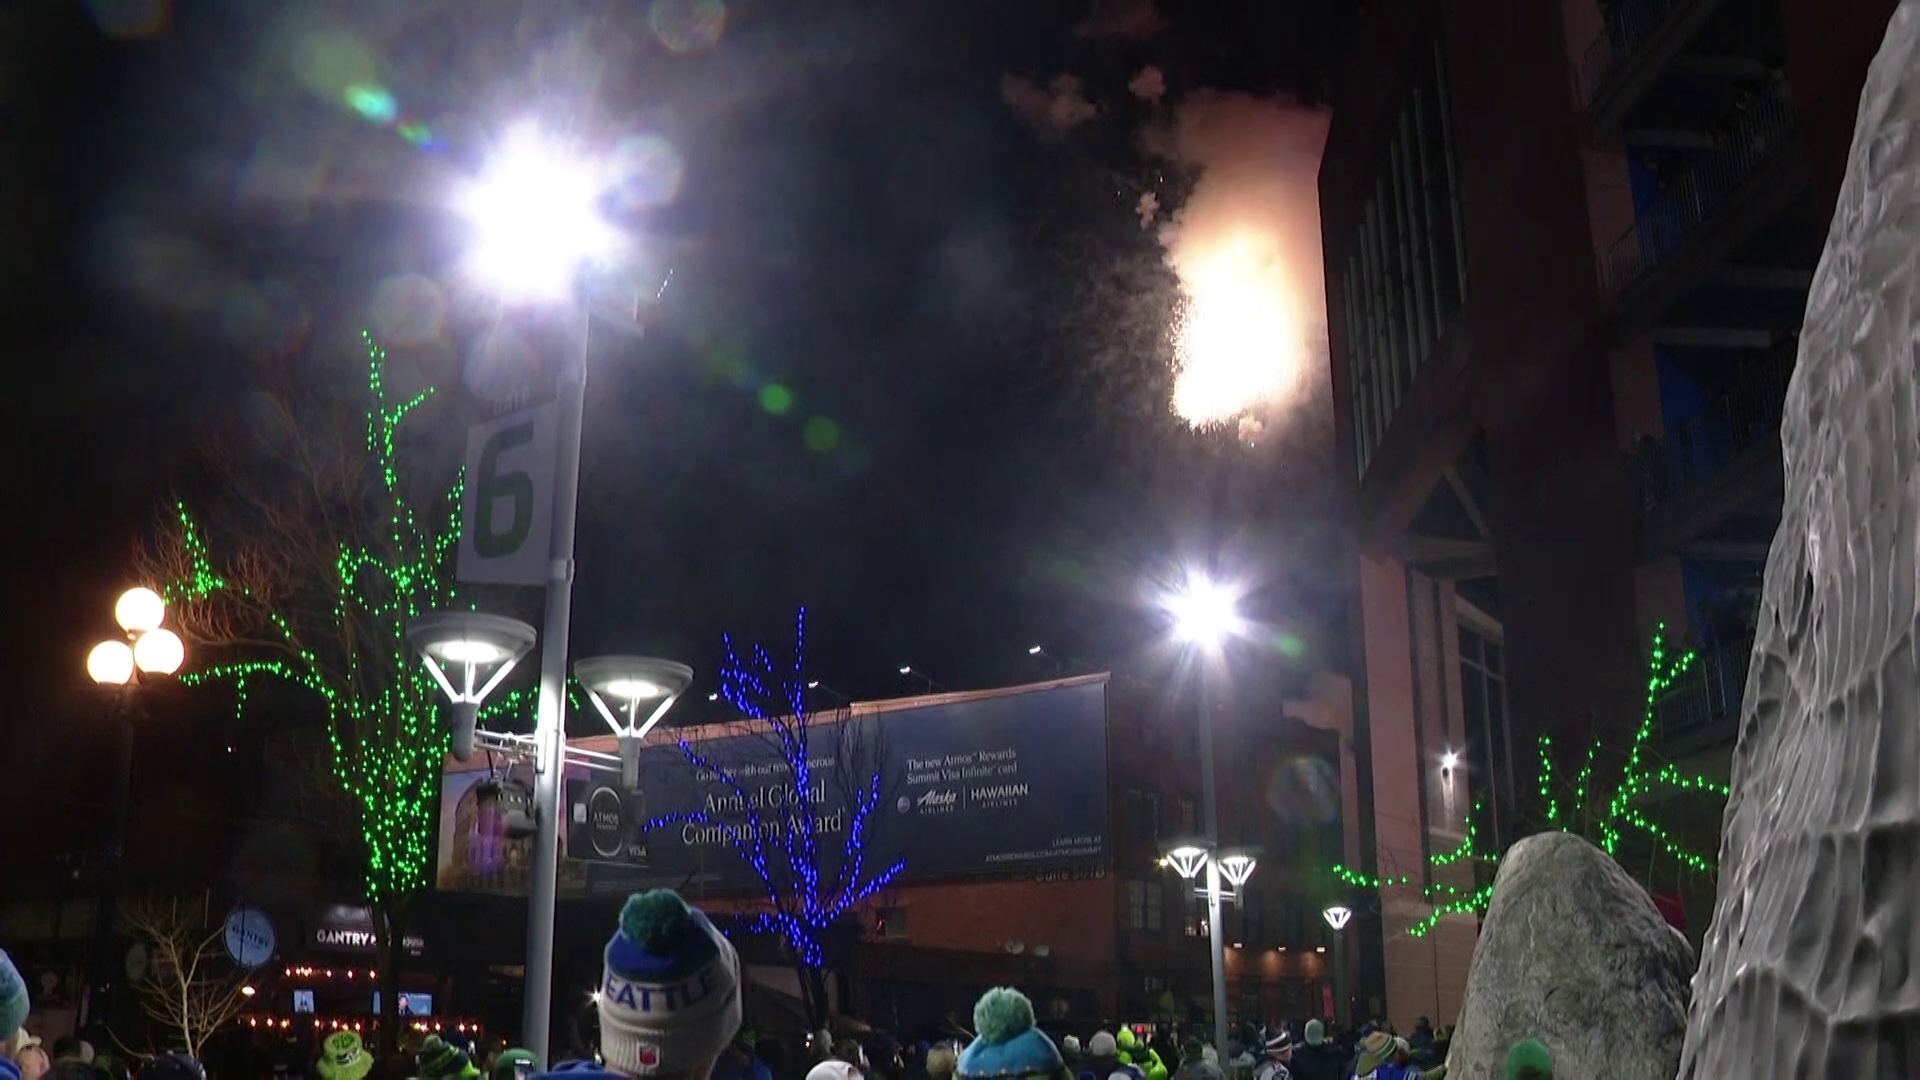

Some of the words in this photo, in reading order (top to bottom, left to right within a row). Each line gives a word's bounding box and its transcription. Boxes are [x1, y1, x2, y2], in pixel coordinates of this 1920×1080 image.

[474, 420, 534, 560] 6
[907, 759, 922, 771] The
[925, 759, 941, 769] new
[979, 748, 1016, 762] Rewards
[907, 771, 939, 785] Summit
[942, 768, 960, 780] Visa
[998, 761, 1017, 774] card
[768, 778, 826, 808] Gloal
[917, 788, 957, 806] Alaska
[971, 783, 1029, 800] HAWAIIAN
[682, 818, 781, 847] Companon
[628, 845, 648, 857] VISA
[315, 928, 369, 946] GANTRY
